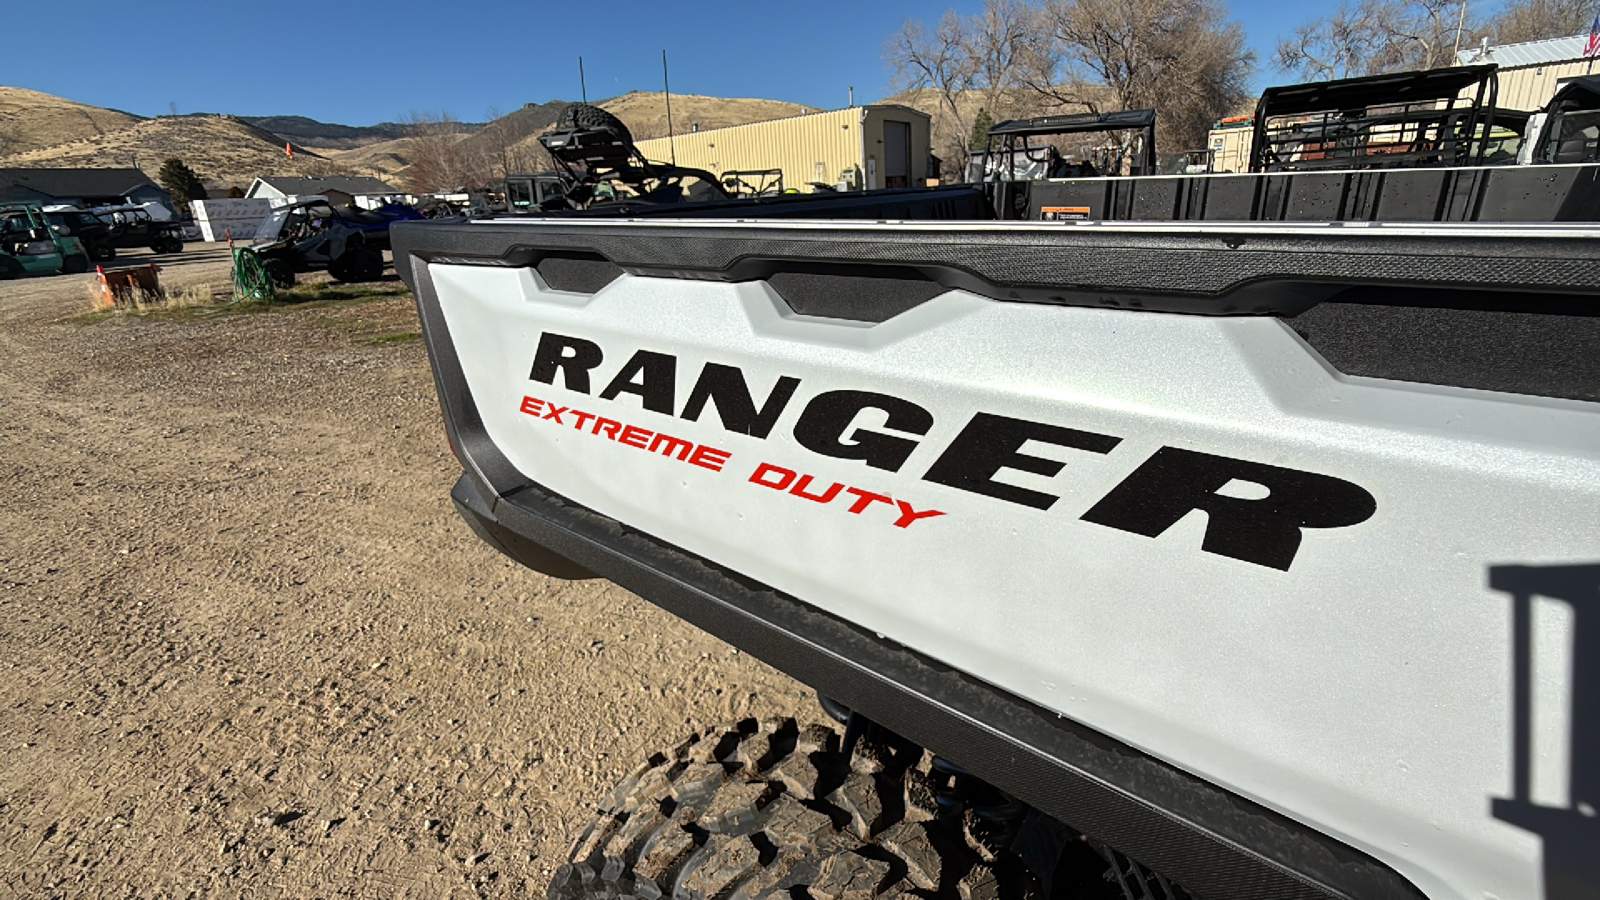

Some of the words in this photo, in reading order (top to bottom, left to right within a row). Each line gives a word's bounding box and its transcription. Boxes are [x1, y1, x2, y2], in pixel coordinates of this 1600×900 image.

[519, 395, 732, 472] EXTREME
[748, 462, 945, 529] DUTY
[529, 331, 1377, 572] RANGER
